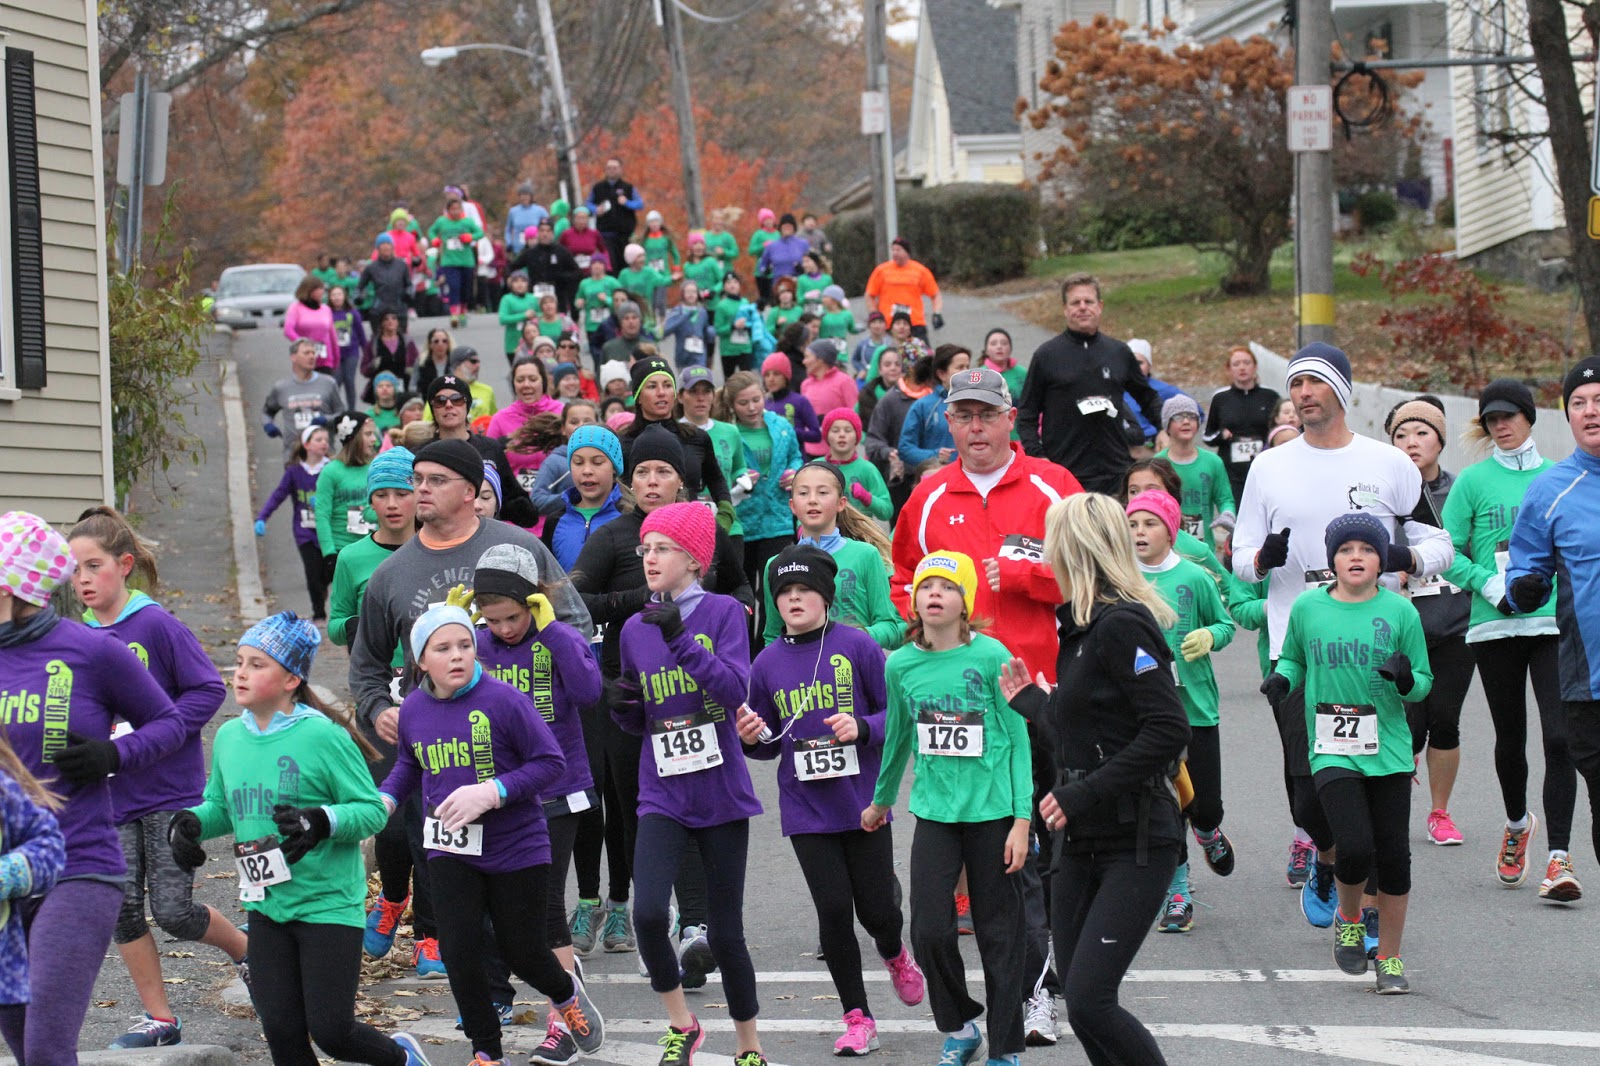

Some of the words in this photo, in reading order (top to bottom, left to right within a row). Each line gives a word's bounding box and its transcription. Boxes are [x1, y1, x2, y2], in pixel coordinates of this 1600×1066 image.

[968, 371, 982, 384] B
[430, 566, 476, 589] ENG
[777, 561, 810, 577] fearless
[1327, 636, 1370, 671] girls
[488, 664, 530, 693] irls
[650, 664, 698, 706] girls
[0, 689, 41, 724] irls
[789, 680, 835, 720] girls
[928, 725, 969, 751] 176
[1333, 715, 1361, 739] 27
[426, 737, 472, 775] girls
[660, 728, 706, 759] 148
[803, 747, 847, 775] 155
[232, 781, 276, 821] girls
[239, 854, 276, 883] 182
